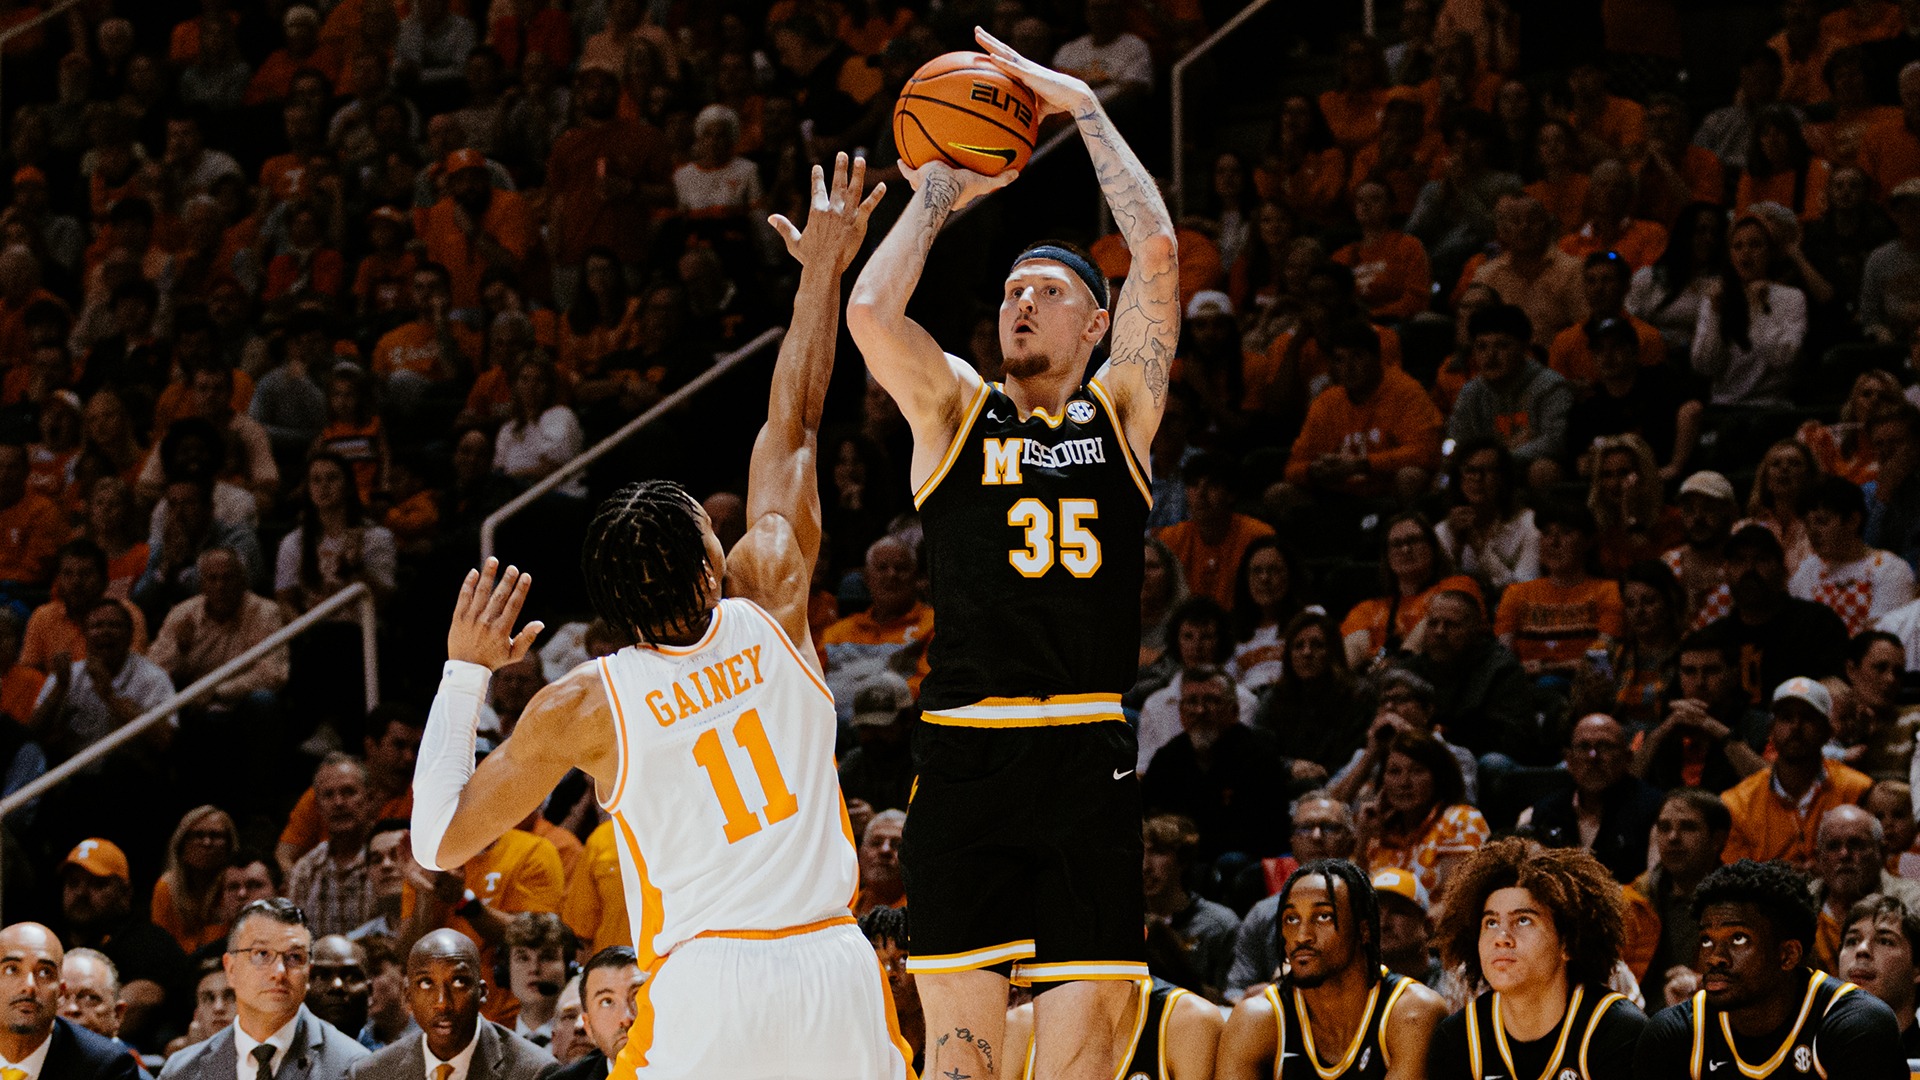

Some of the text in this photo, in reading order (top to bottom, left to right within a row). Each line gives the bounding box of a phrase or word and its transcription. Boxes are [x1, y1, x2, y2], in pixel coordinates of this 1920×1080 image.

[971, 80, 1033, 129] ELITE
[1067, 401, 1095, 423] SEC
[982, 437, 1106, 485] MISSOURI
[1007, 498, 1102, 578] 35
[645, 644, 764, 727] GAINEY
[692, 708, 799, 844] 11
[485, 872, 502, 891] T
